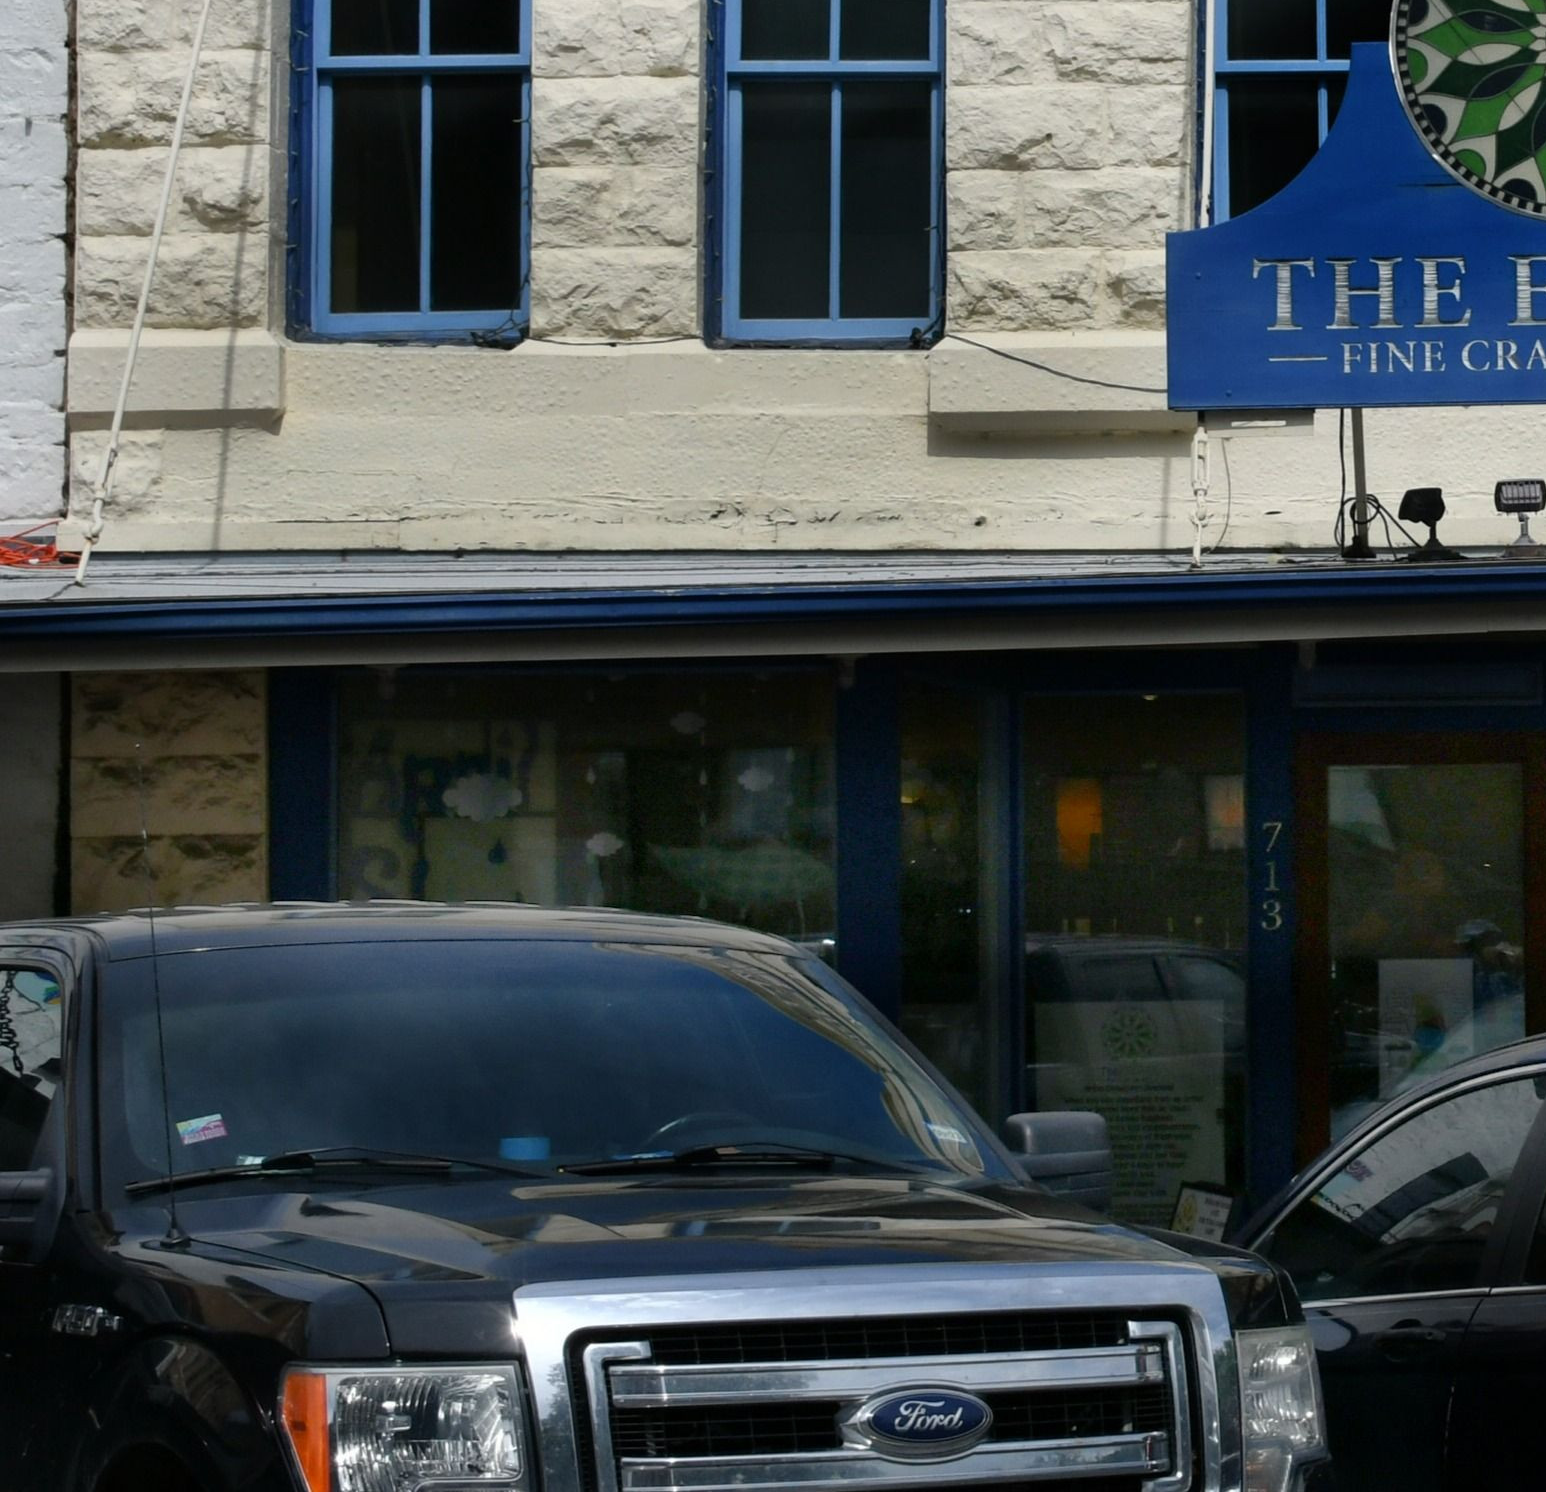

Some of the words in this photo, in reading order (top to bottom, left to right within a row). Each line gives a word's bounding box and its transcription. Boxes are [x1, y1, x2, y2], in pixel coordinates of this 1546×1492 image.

[1253, 256, 1472, 331] THE
[1341, 341, 1446, 374] FINE
[1261, 822, 1283, 931] 713
[894, 1400, 963, 1430] Ford
